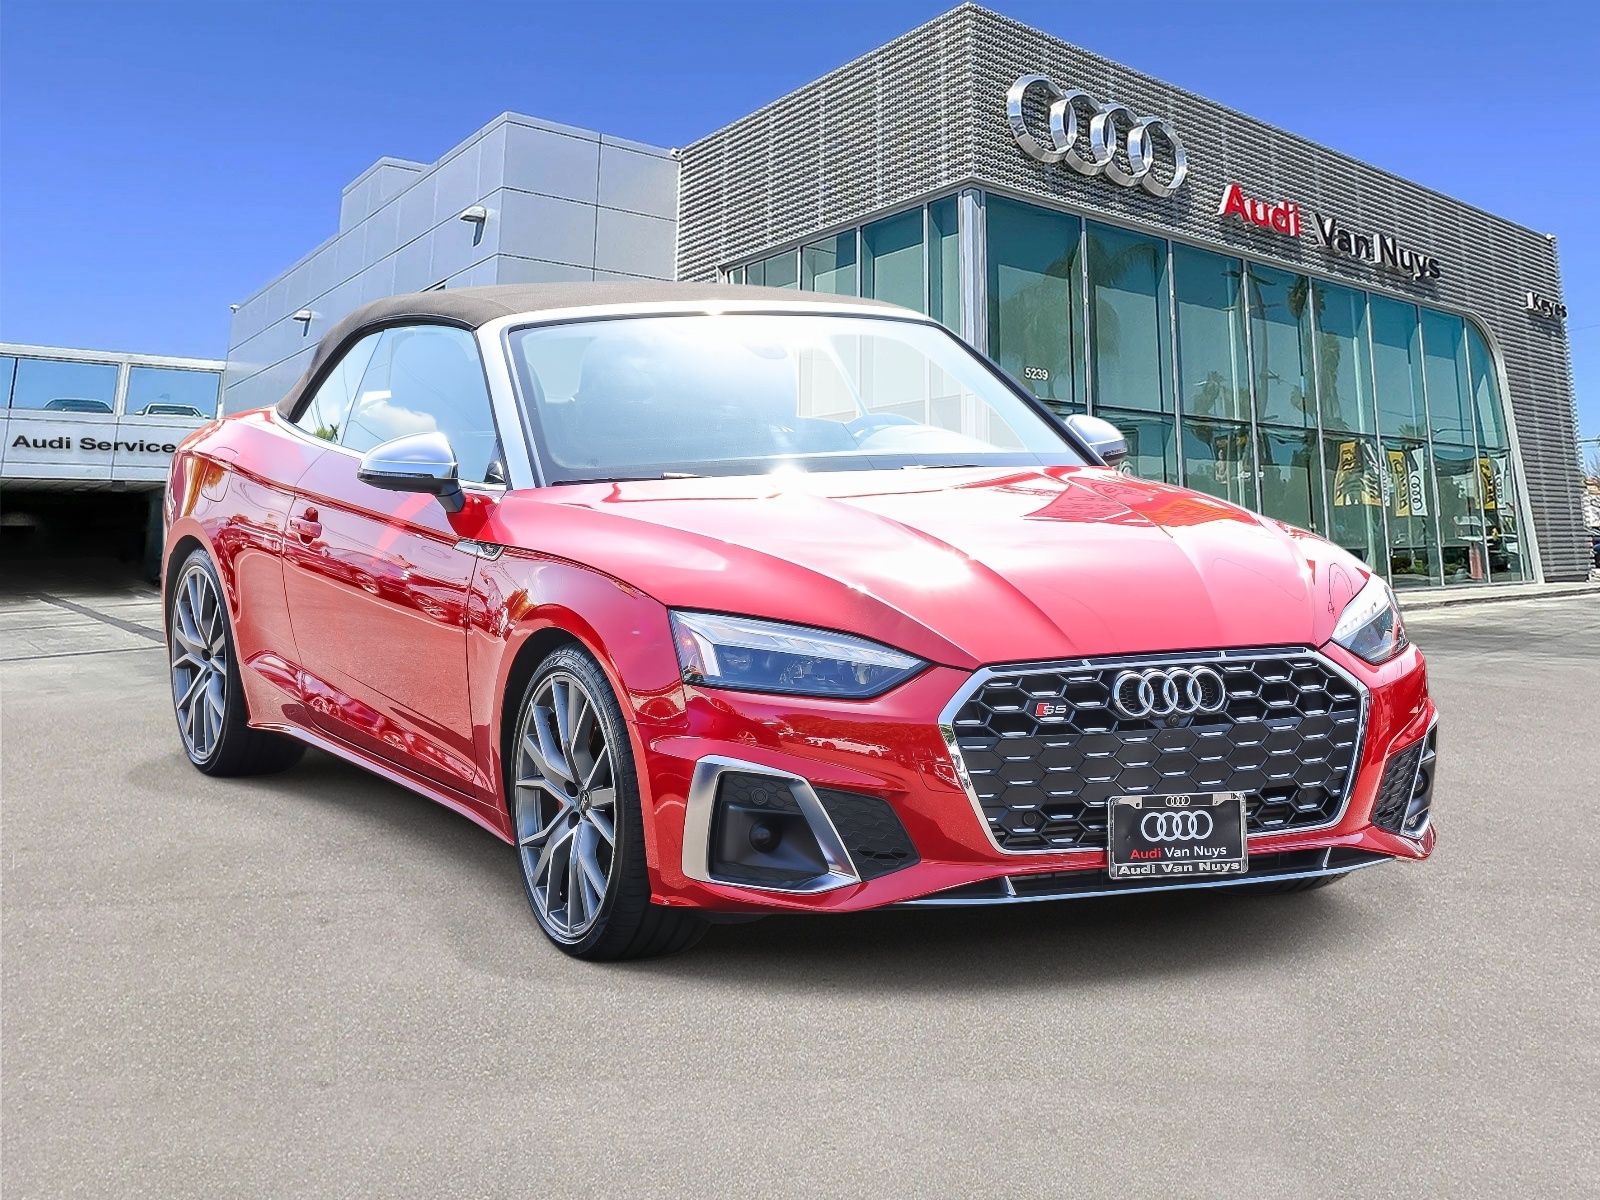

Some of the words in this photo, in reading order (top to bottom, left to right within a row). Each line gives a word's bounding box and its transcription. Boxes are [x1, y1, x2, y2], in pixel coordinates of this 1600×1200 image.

[1218, 181, 1302, 238] Audi
[1311, 212, 1370, 259] Van
[1373, 233, 1441, 280] Nuys
[1526, 292, 1568, 318] Keyes
[1024, 367, 1049, 380] 5239
[12, 435, 71, 449] Audi
[80, 437, 177, 453] Service
[1130, 848, 1162, 860] Audi
[1165, 847, 1190, 858] Van
[1194, 846, 1227, 858] Nuys
[1118, 865, 1156, 875] Audi
[1161, 863, 1193, 873] Van
[1198, 862, 1240, 873] Nuys
